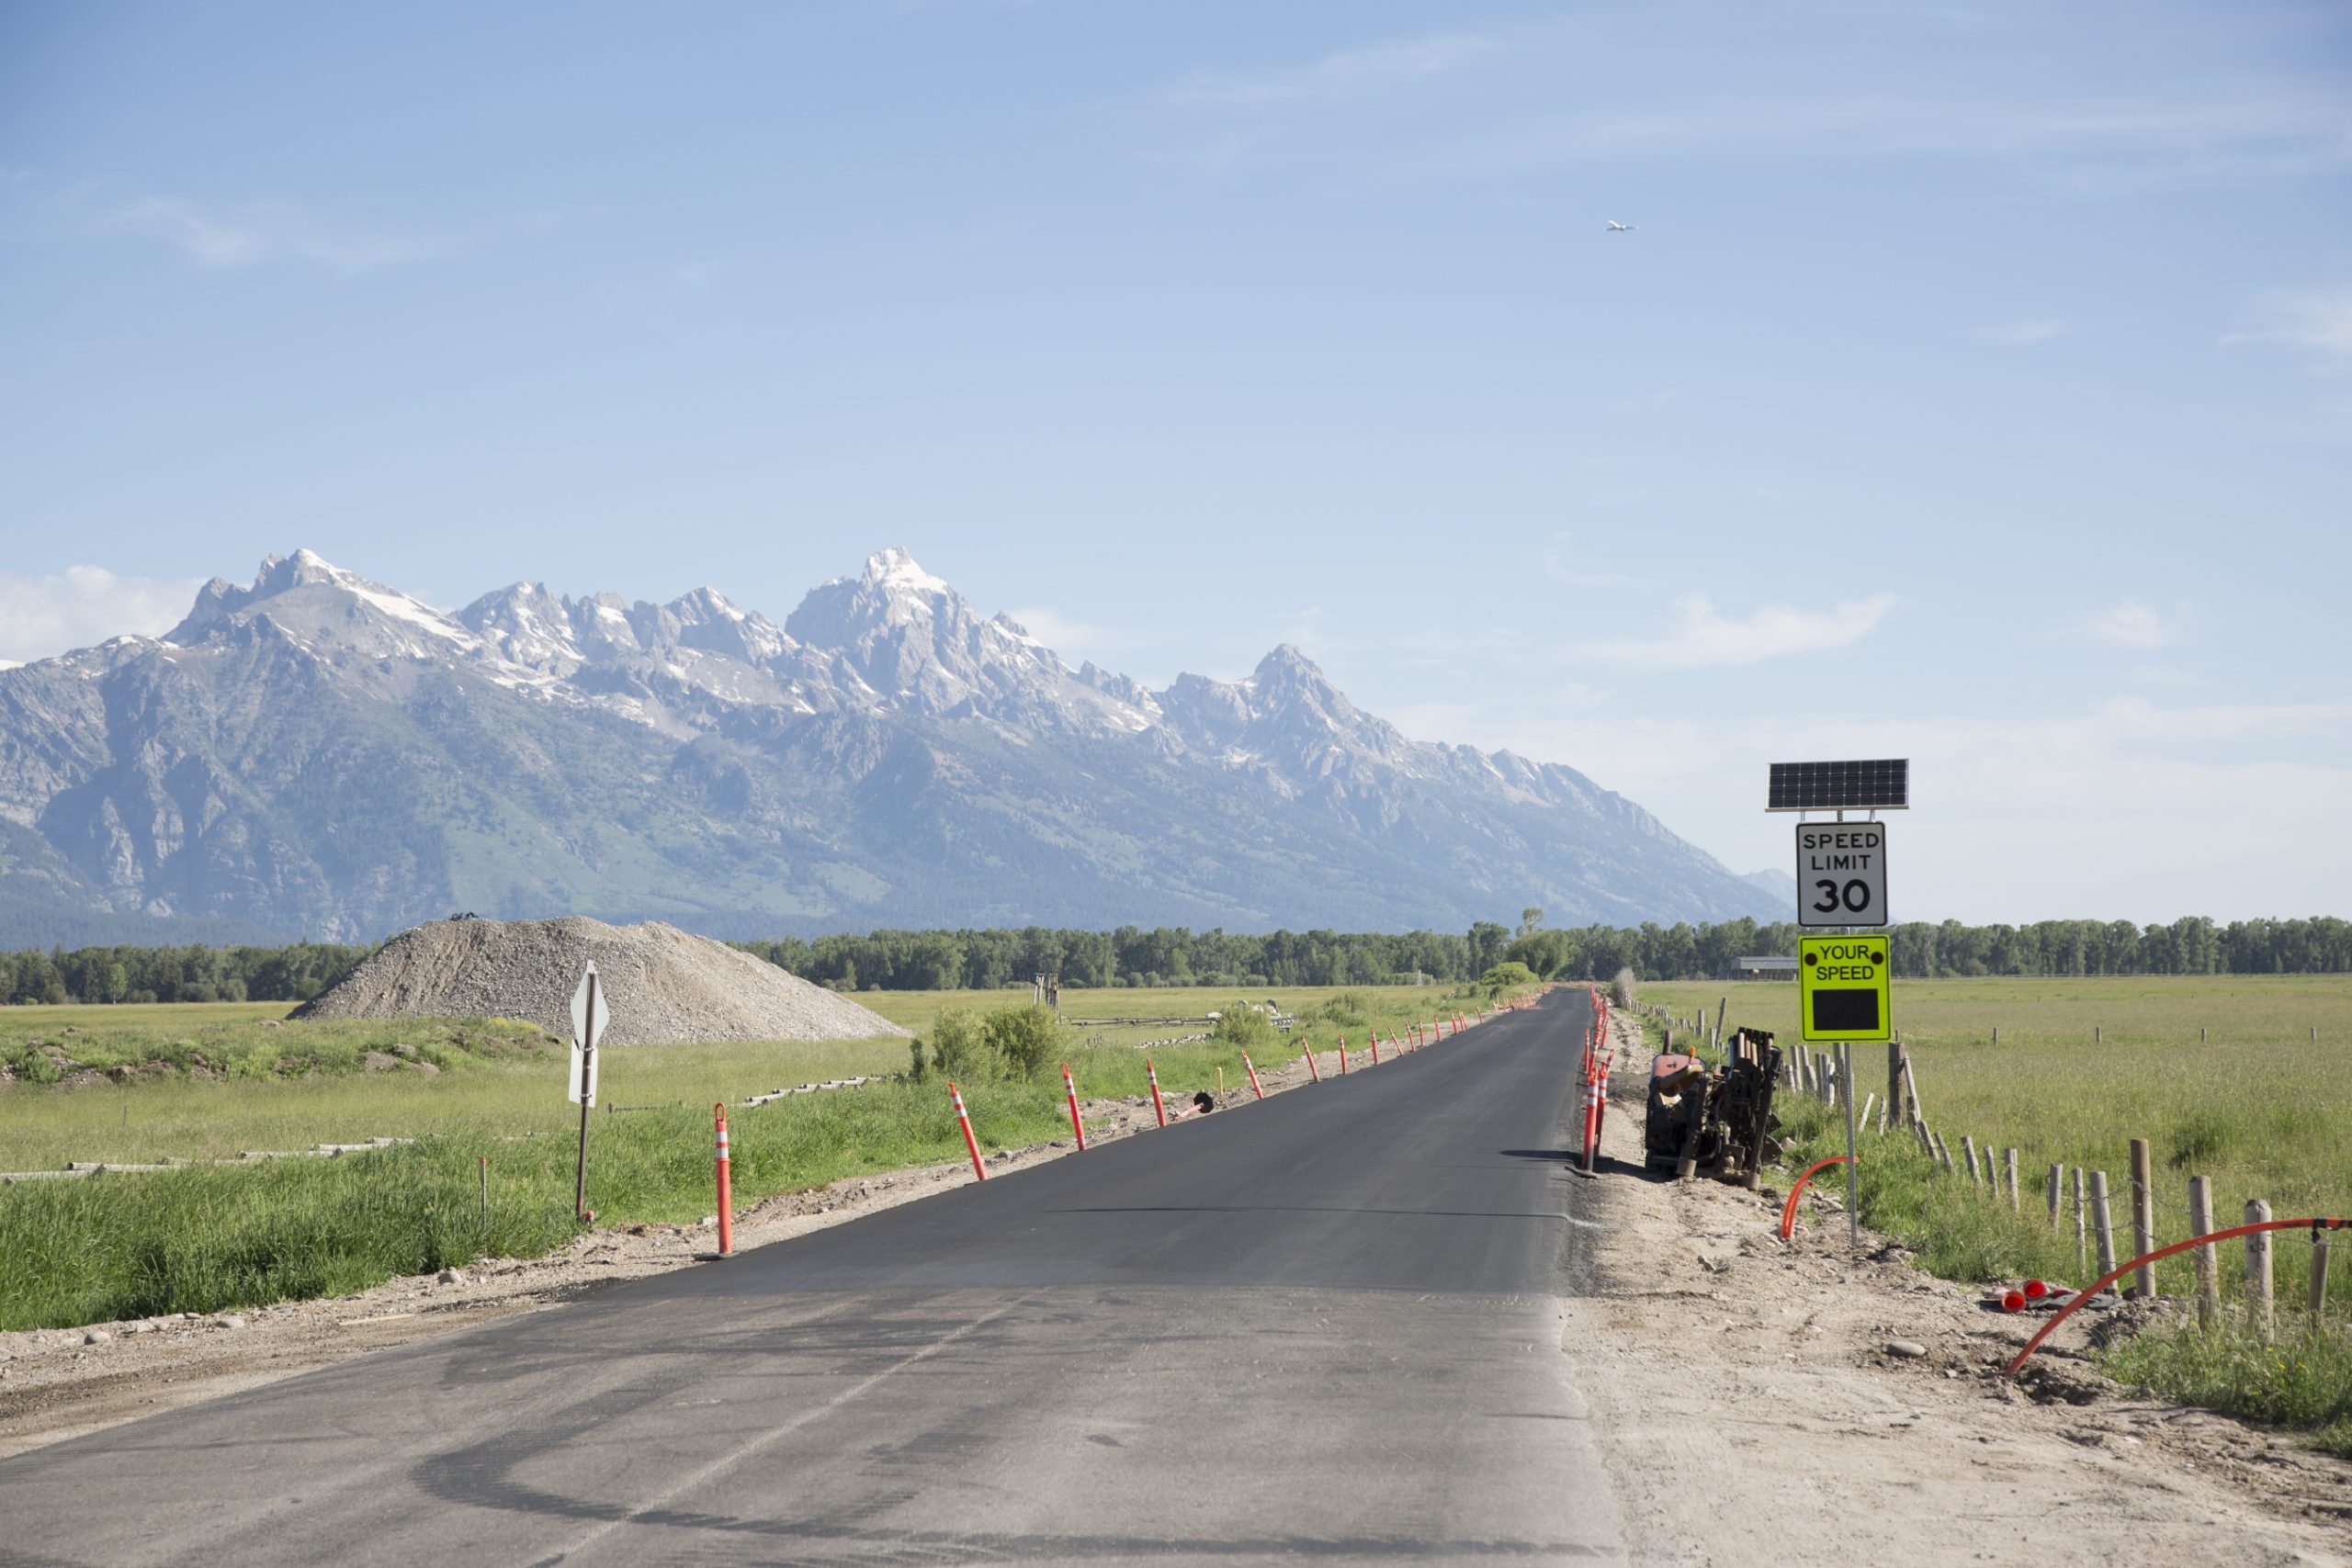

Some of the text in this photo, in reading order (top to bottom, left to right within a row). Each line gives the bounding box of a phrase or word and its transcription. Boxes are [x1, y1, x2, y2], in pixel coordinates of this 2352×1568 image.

[1803, 833, 1879, 849] SPEED
[1812, 855, 1871, 870] LIMIT
[1814, 879, 1870, 912] 30
[1819, 945, 1870, 960] YOUR
[1816, 966, 1874, 980] SPEED
